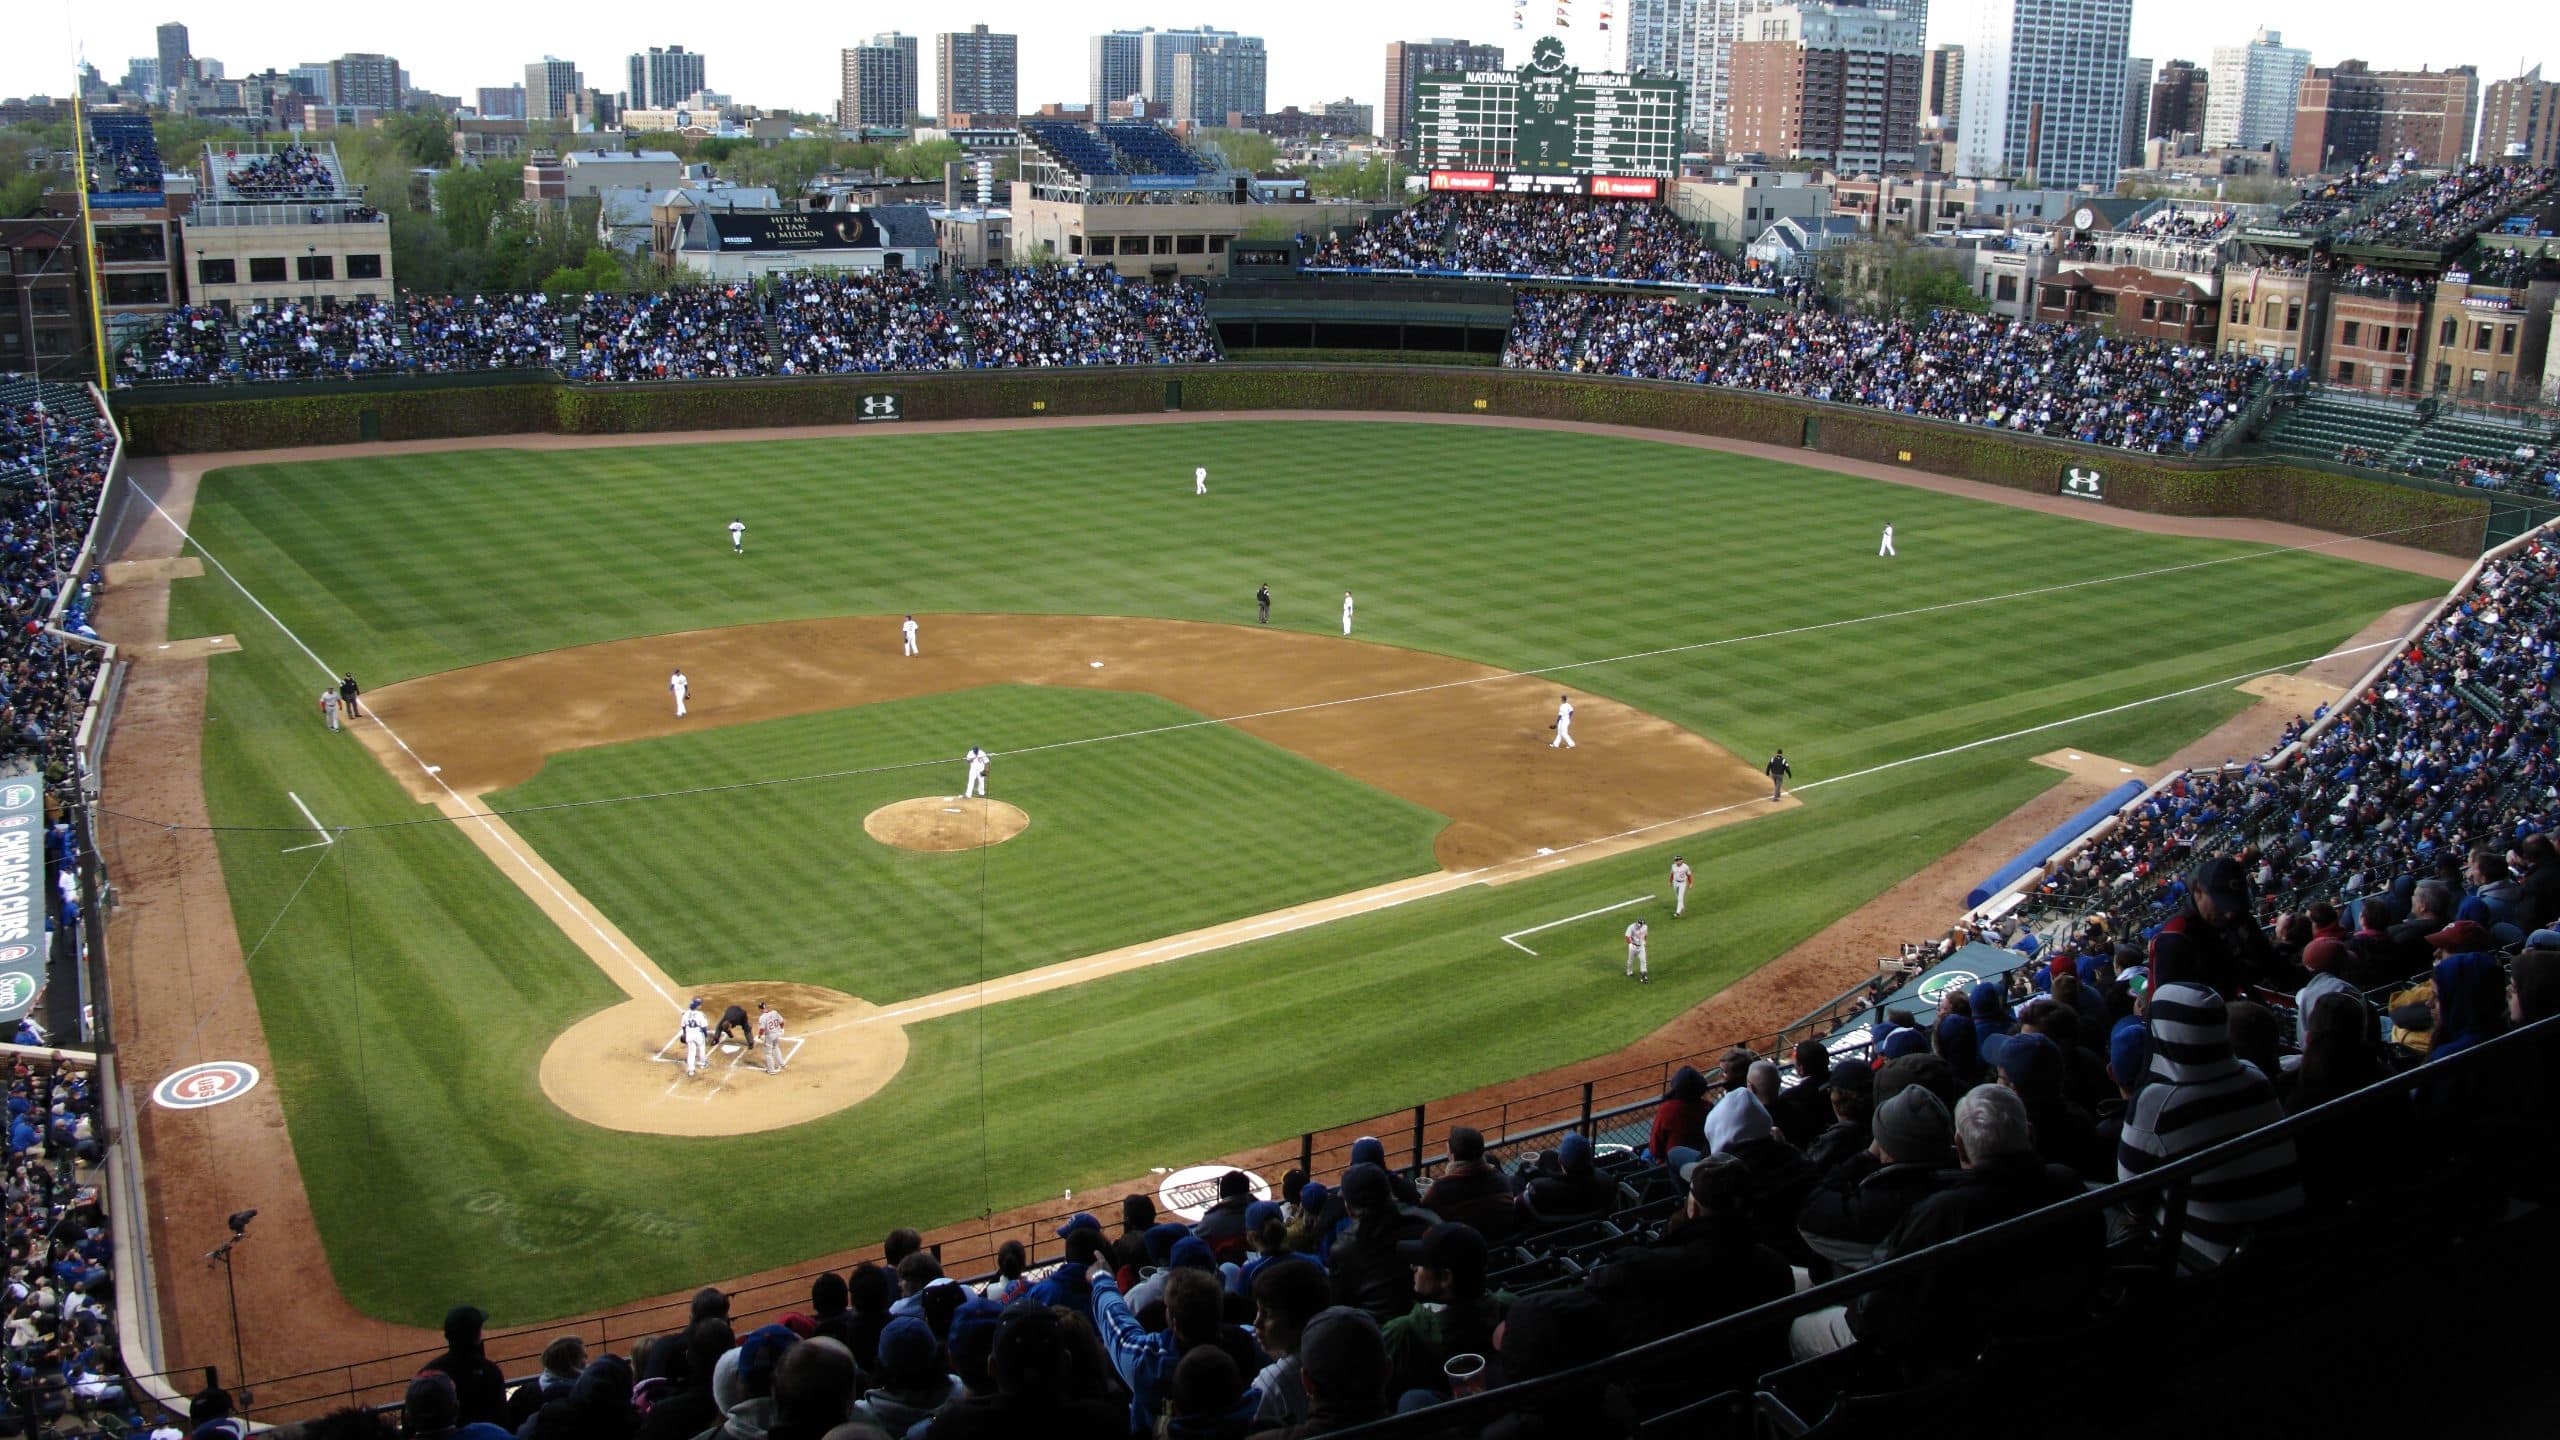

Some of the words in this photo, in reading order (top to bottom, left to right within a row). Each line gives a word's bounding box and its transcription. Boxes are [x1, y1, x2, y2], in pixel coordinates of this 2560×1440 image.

[1466, 72, 1519, 84] NATIONAL
[1575, 75, 1631, 87] AMERICAN
[1534, 93, 1559, 102] BATTER
[1537, 102, 1555, 113] 20
[1541, 146, 1548, 158] 2
[0, 830, 30, 896] CHICAGO
[0, 895, 29, 943] CUBS
[768, 1019, 780, 1031] 20
